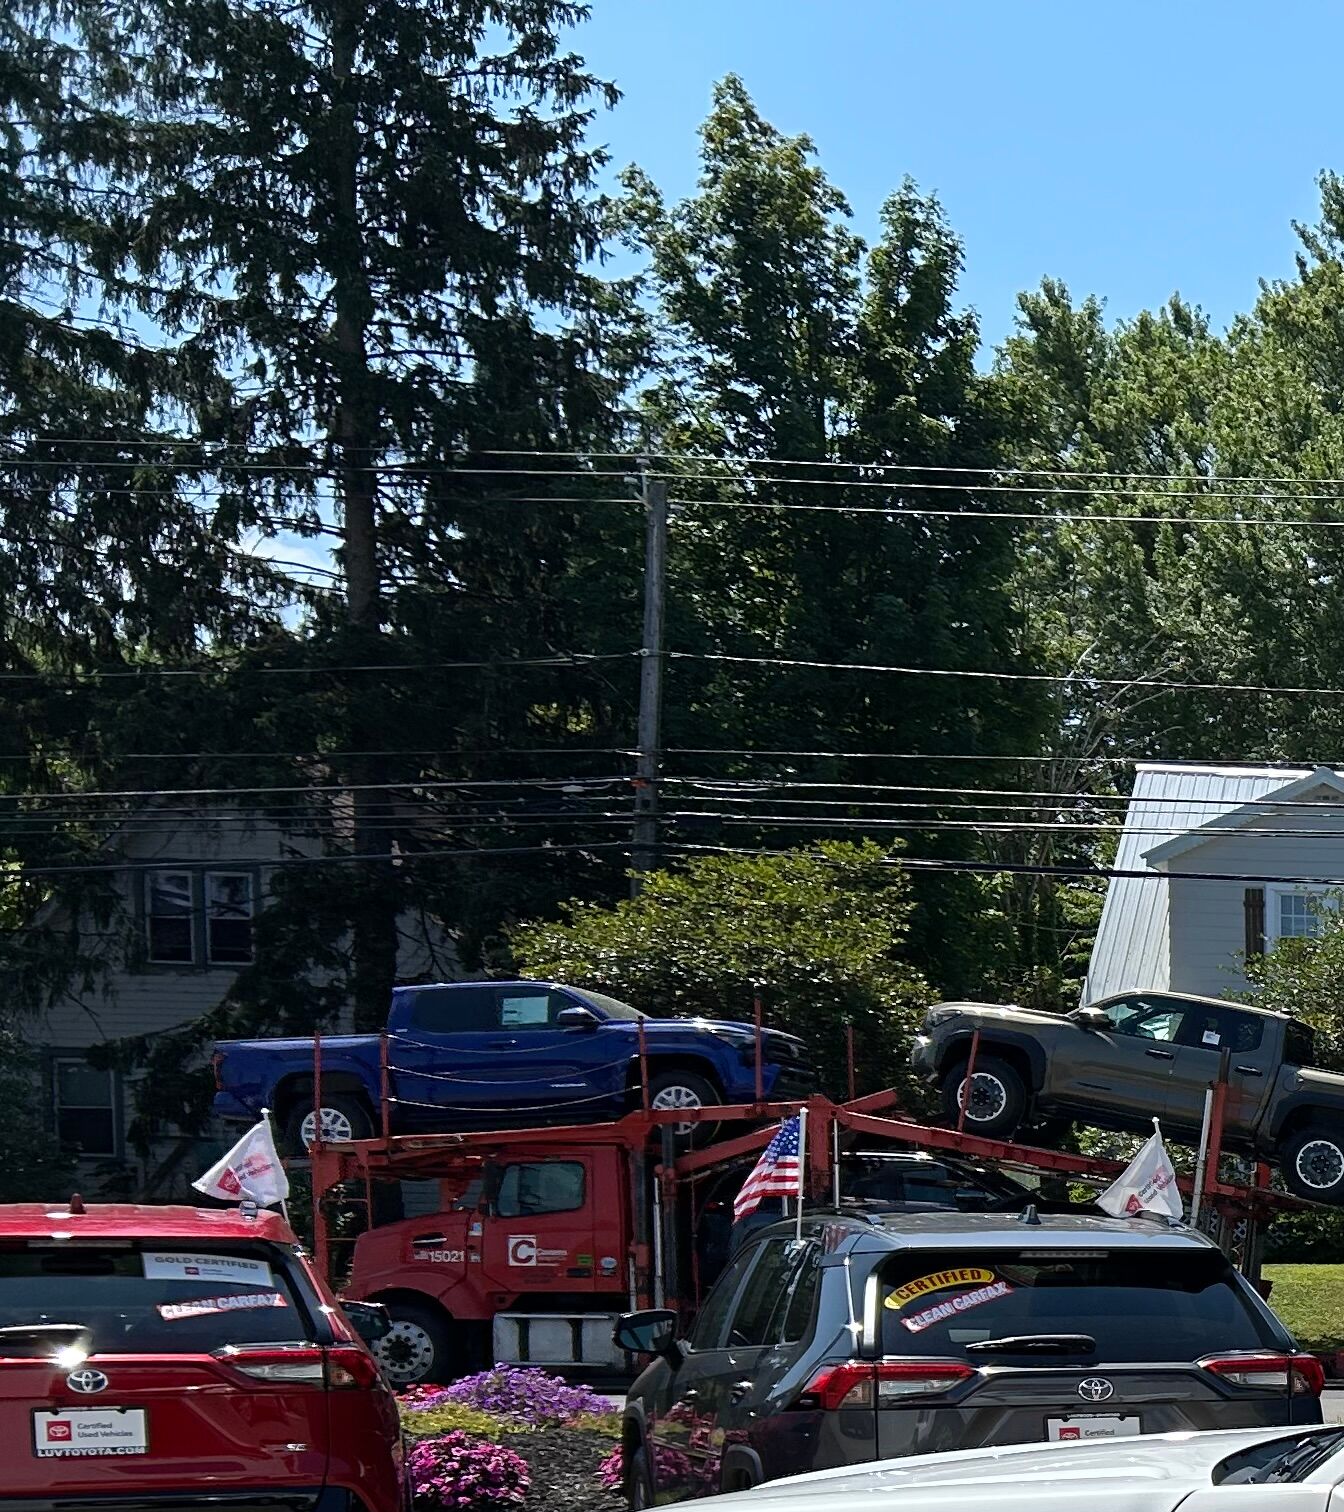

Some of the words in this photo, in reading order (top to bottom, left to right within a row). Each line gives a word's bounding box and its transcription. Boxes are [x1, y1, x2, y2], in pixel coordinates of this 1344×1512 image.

[428, 1250, 465, 1263] 15021
[511, 1239, 536, 1264] C
[154, 1256, 193, 1264] GOLD
[194, 1257, 259, 1270] CERTIFIED
[895, 1269, 982, 1300] CERTIFIED
[217, 1293, 280, 1309] CARFAX
[952, 1281, 1010, 1311] CARFAX
[77, 1422, 113, 1430] Certified
[100, 1430, 133, 1438] Vehicles
[1084, 1429, 1115, 1437] Certified
[37, 1447, 146, 1457] LUVTOYOTA.COM
